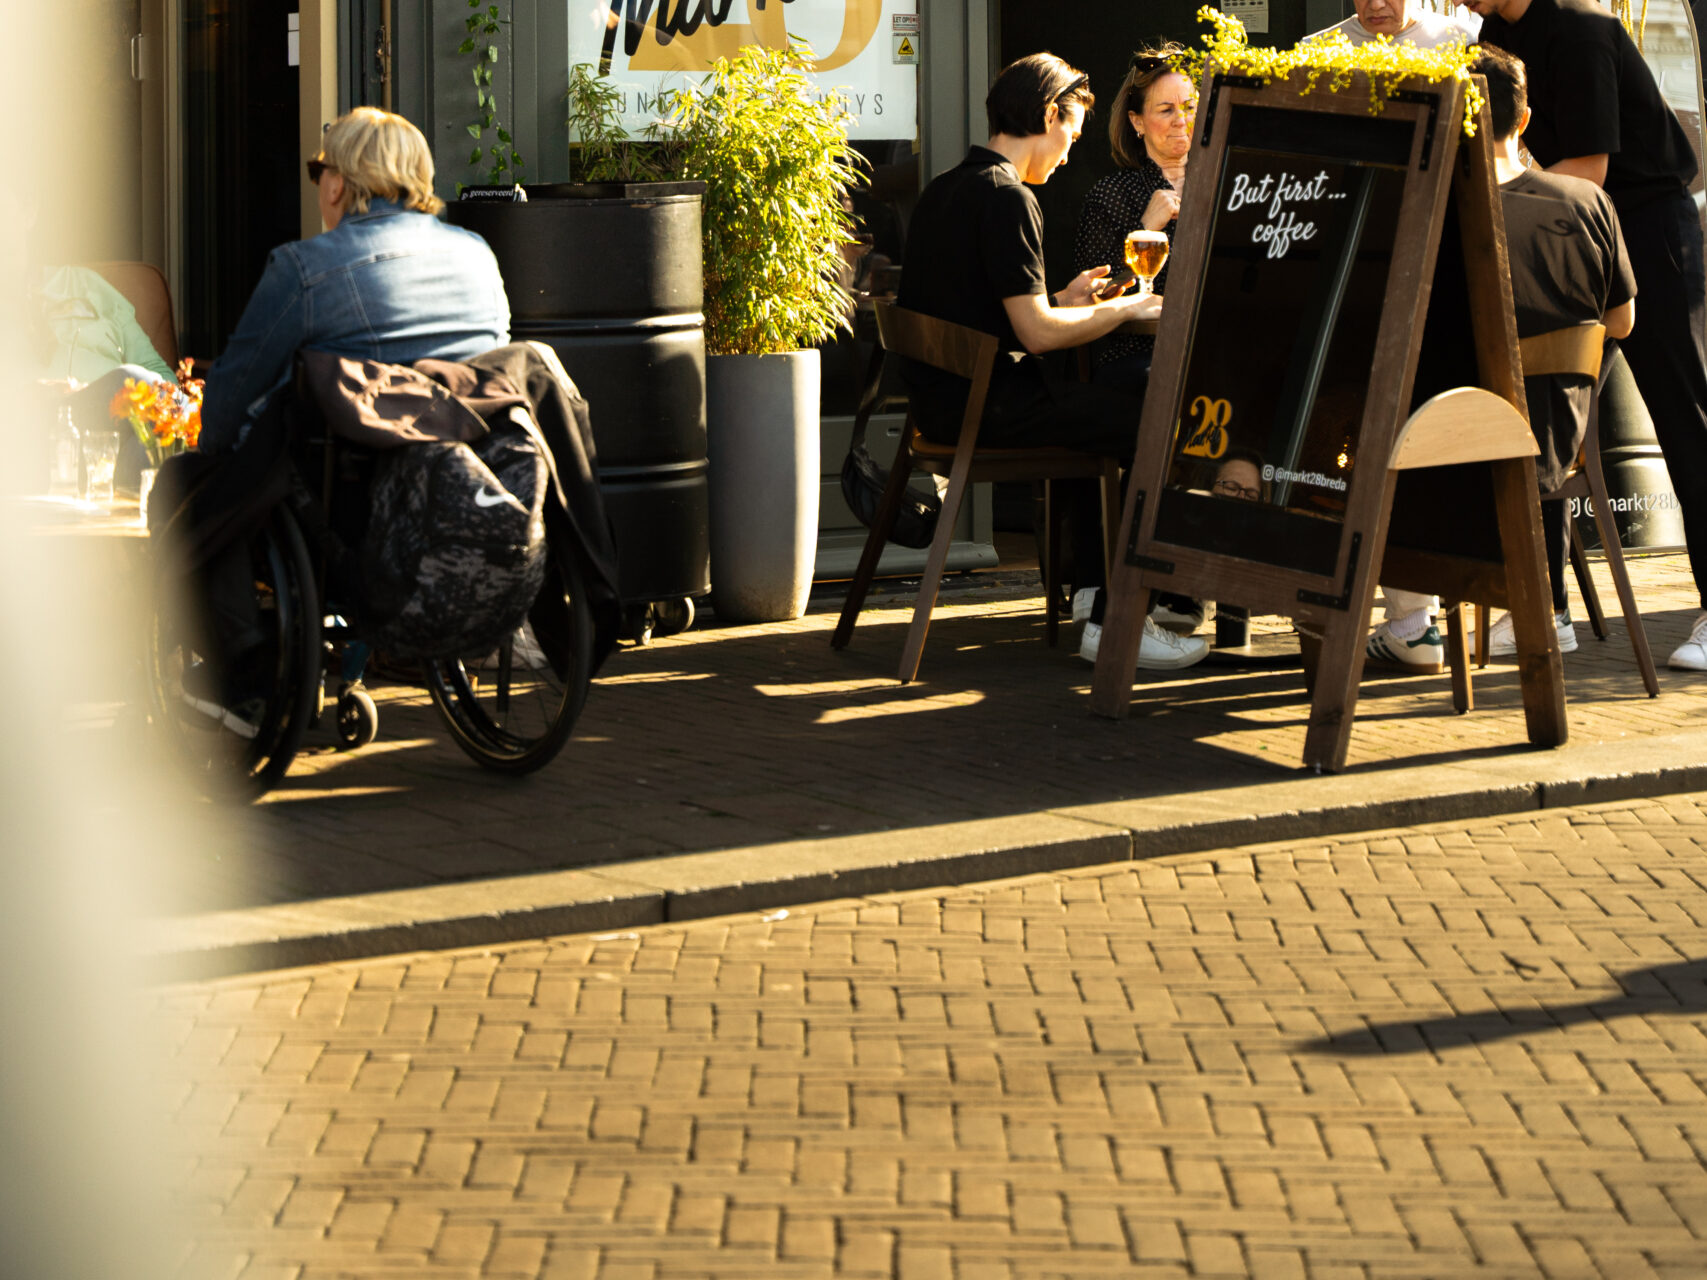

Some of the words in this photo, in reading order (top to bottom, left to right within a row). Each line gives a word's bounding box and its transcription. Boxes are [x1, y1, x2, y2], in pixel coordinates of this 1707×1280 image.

[1227, 173, 1274, 211] But
[1251, 211, 1318, 259] coffee
[1182, 395, 1232, 459] 28
[1275, 468, 1347, 491] @markt28breda
